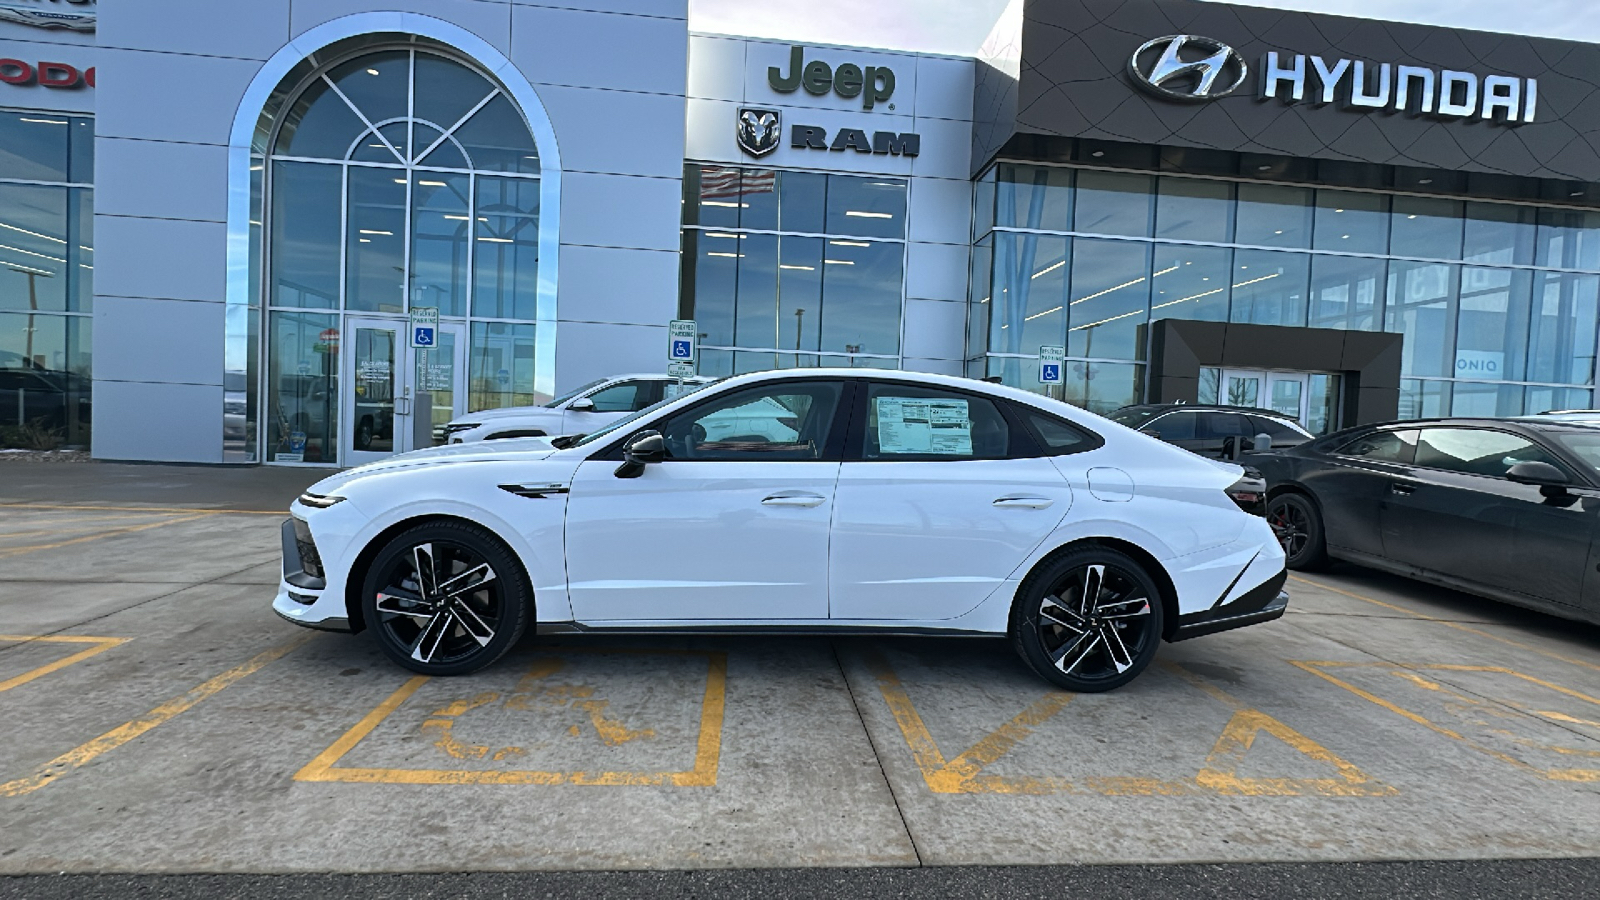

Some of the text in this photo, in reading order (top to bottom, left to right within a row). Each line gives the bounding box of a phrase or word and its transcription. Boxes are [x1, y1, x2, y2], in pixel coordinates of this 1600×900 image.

[0, 58, 95, 88] OD
[767, 45, 896, 110] Jeep
[1264, 51, 1538, 124] HYUNDAI
[791, 124, 920, 157] RAM
[412, 309, 437, 317] RESERVED
